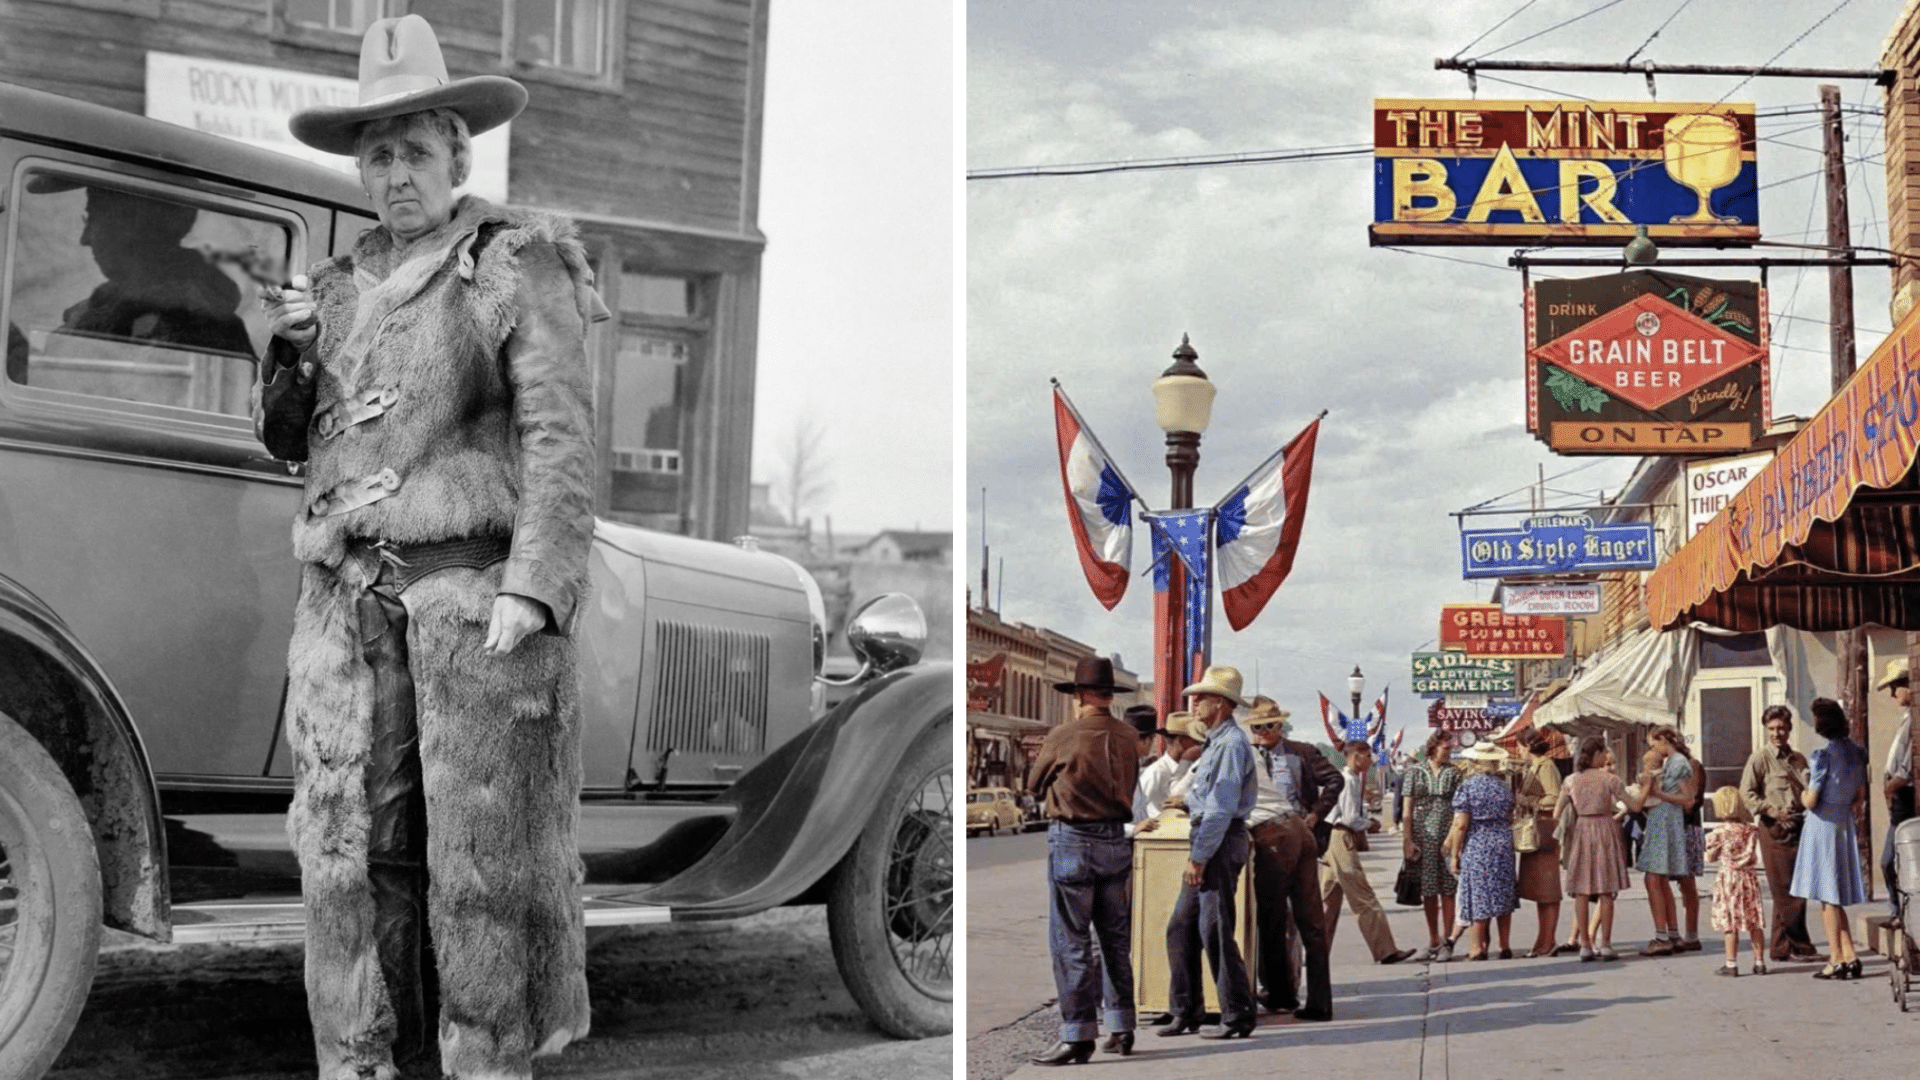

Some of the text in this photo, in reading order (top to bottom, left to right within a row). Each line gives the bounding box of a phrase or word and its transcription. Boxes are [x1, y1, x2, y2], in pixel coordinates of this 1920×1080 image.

[188, 67, 258, 110] ROCKY
[1387, 104, 1647, 152] THE MINT
[1392, 140, 1632, 223] BAR
[1549, 304, 1598, 316] DRINK
[1569, 339, 1726, 364] GRAIN BELT
[1615, 370, 1682, 388] BEER
[1688, 382, 1754, 415] friendly!
[1579, 427, 1724, 443] ON TAP
[1761, 368, 1920, 537] BARBER SHO
[1693, 466, 1748, 492] OSCAR
[1471, 534, 1648, 565] Old Style Lager
[1453, 611, 1530, 627] GREEN
[1459, 629, 1547, 639] PLUMBING
[1476, 641, 1553, 652] HEATING
[1415, 653, 1512, 674] SADDLES
[1432, 670, 1492, 679] LEATHER
[1417, 680, 1511, 691] GARMENTS
[1437, 708, 1493, 719] SAVING
[1442, 720, 1493, 730] & LOAN
